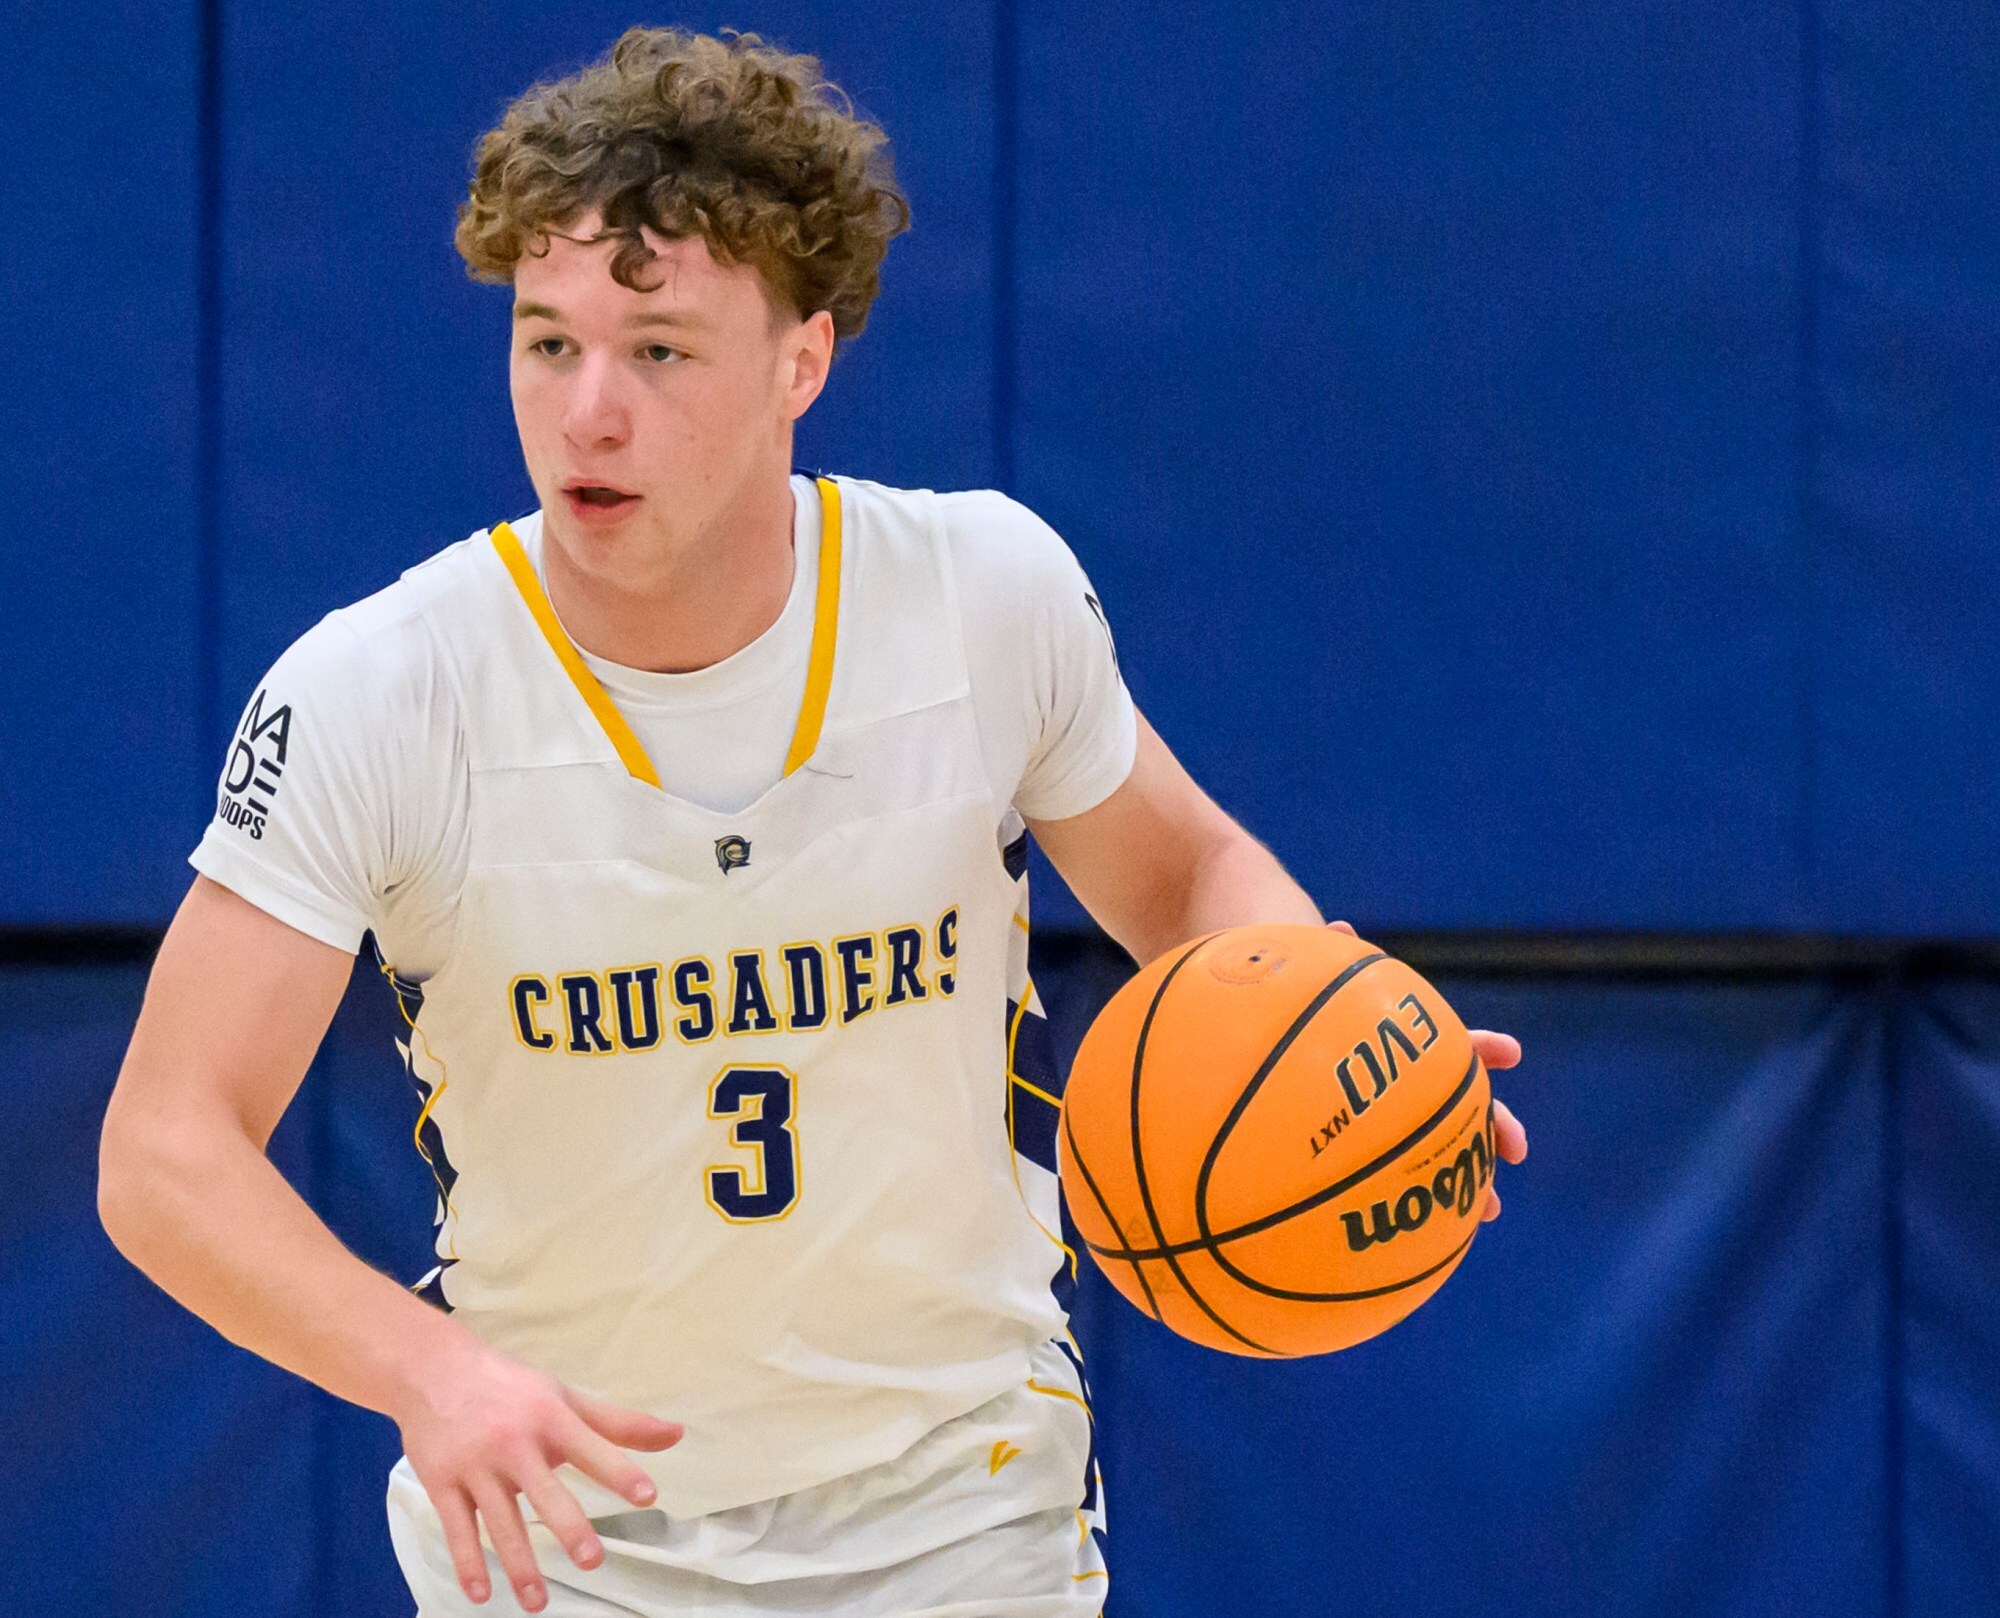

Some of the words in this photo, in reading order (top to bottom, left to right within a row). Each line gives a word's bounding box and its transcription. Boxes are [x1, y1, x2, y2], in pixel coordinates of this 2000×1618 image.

[220, 794, 266, 840] OOPS
[508, 904, 960, 1056] CRUSADERS
[704, 1063, 801, 1225] 3
[1310, 1108, 1350, 1159] NXT
[1339, 1103, 1495, 1252] ilson
